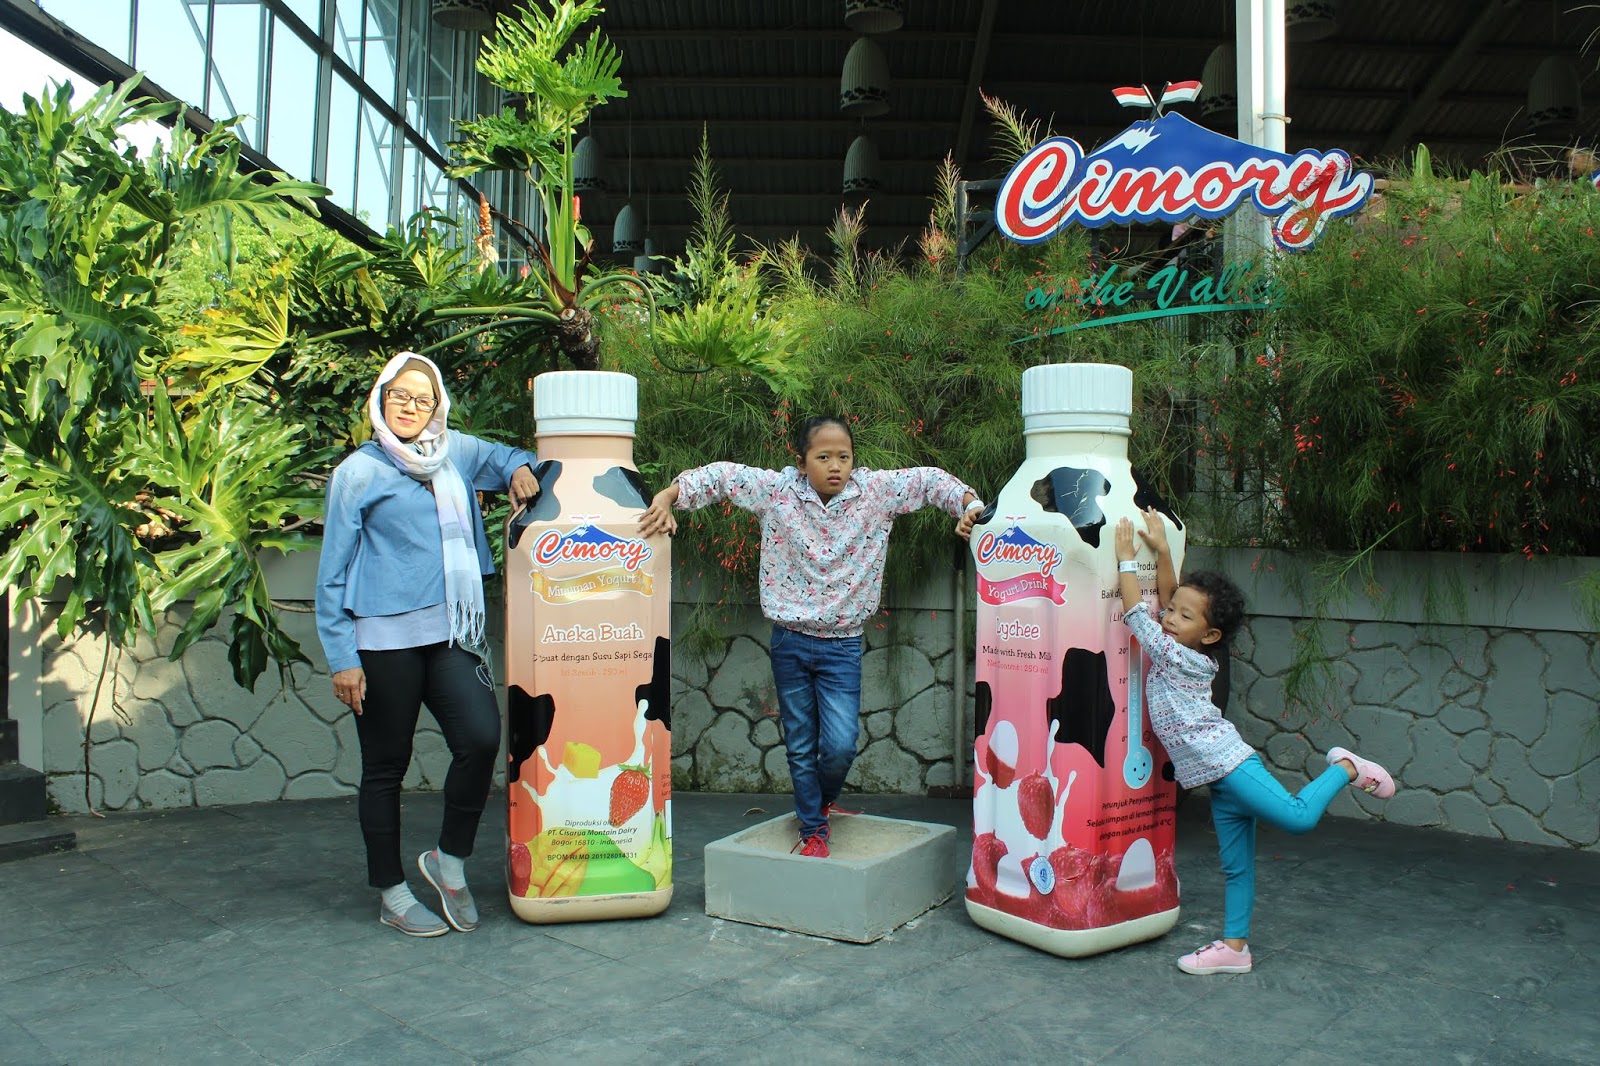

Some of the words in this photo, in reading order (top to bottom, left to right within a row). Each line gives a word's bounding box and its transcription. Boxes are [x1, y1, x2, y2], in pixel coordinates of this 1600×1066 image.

[998, 139, 1373, 248] Cimory
[534, 531, 651, 571] Cimory
[976, 531, 1061, 577] Cimory
[548, 581, 596, 598] Minuman
[597, 573, 637, 588] Yogurt
[988, 585, 1020, 602] Yogurt
[1020, 578, 1048, 591] Drink
[542, 624, 595, 643] Aneka
[600, 623, 644, 642] Buah
[560, 652, 591, 664] dengan
[592, 651, 612, 661] Susu
[614, 650, 631, 662] Sapi
[1000, 648, 1015, 657] with
[1016, 649, 1036, 659] Fresh
[1024, 664, 1038, 673] 250
[564, 819, 602, 828] Diproduksi
[618, 827, 638, 835] Dairy
[551, 839, 572, 847] Bogor
[600, 837, 632, 845] Indonesia
